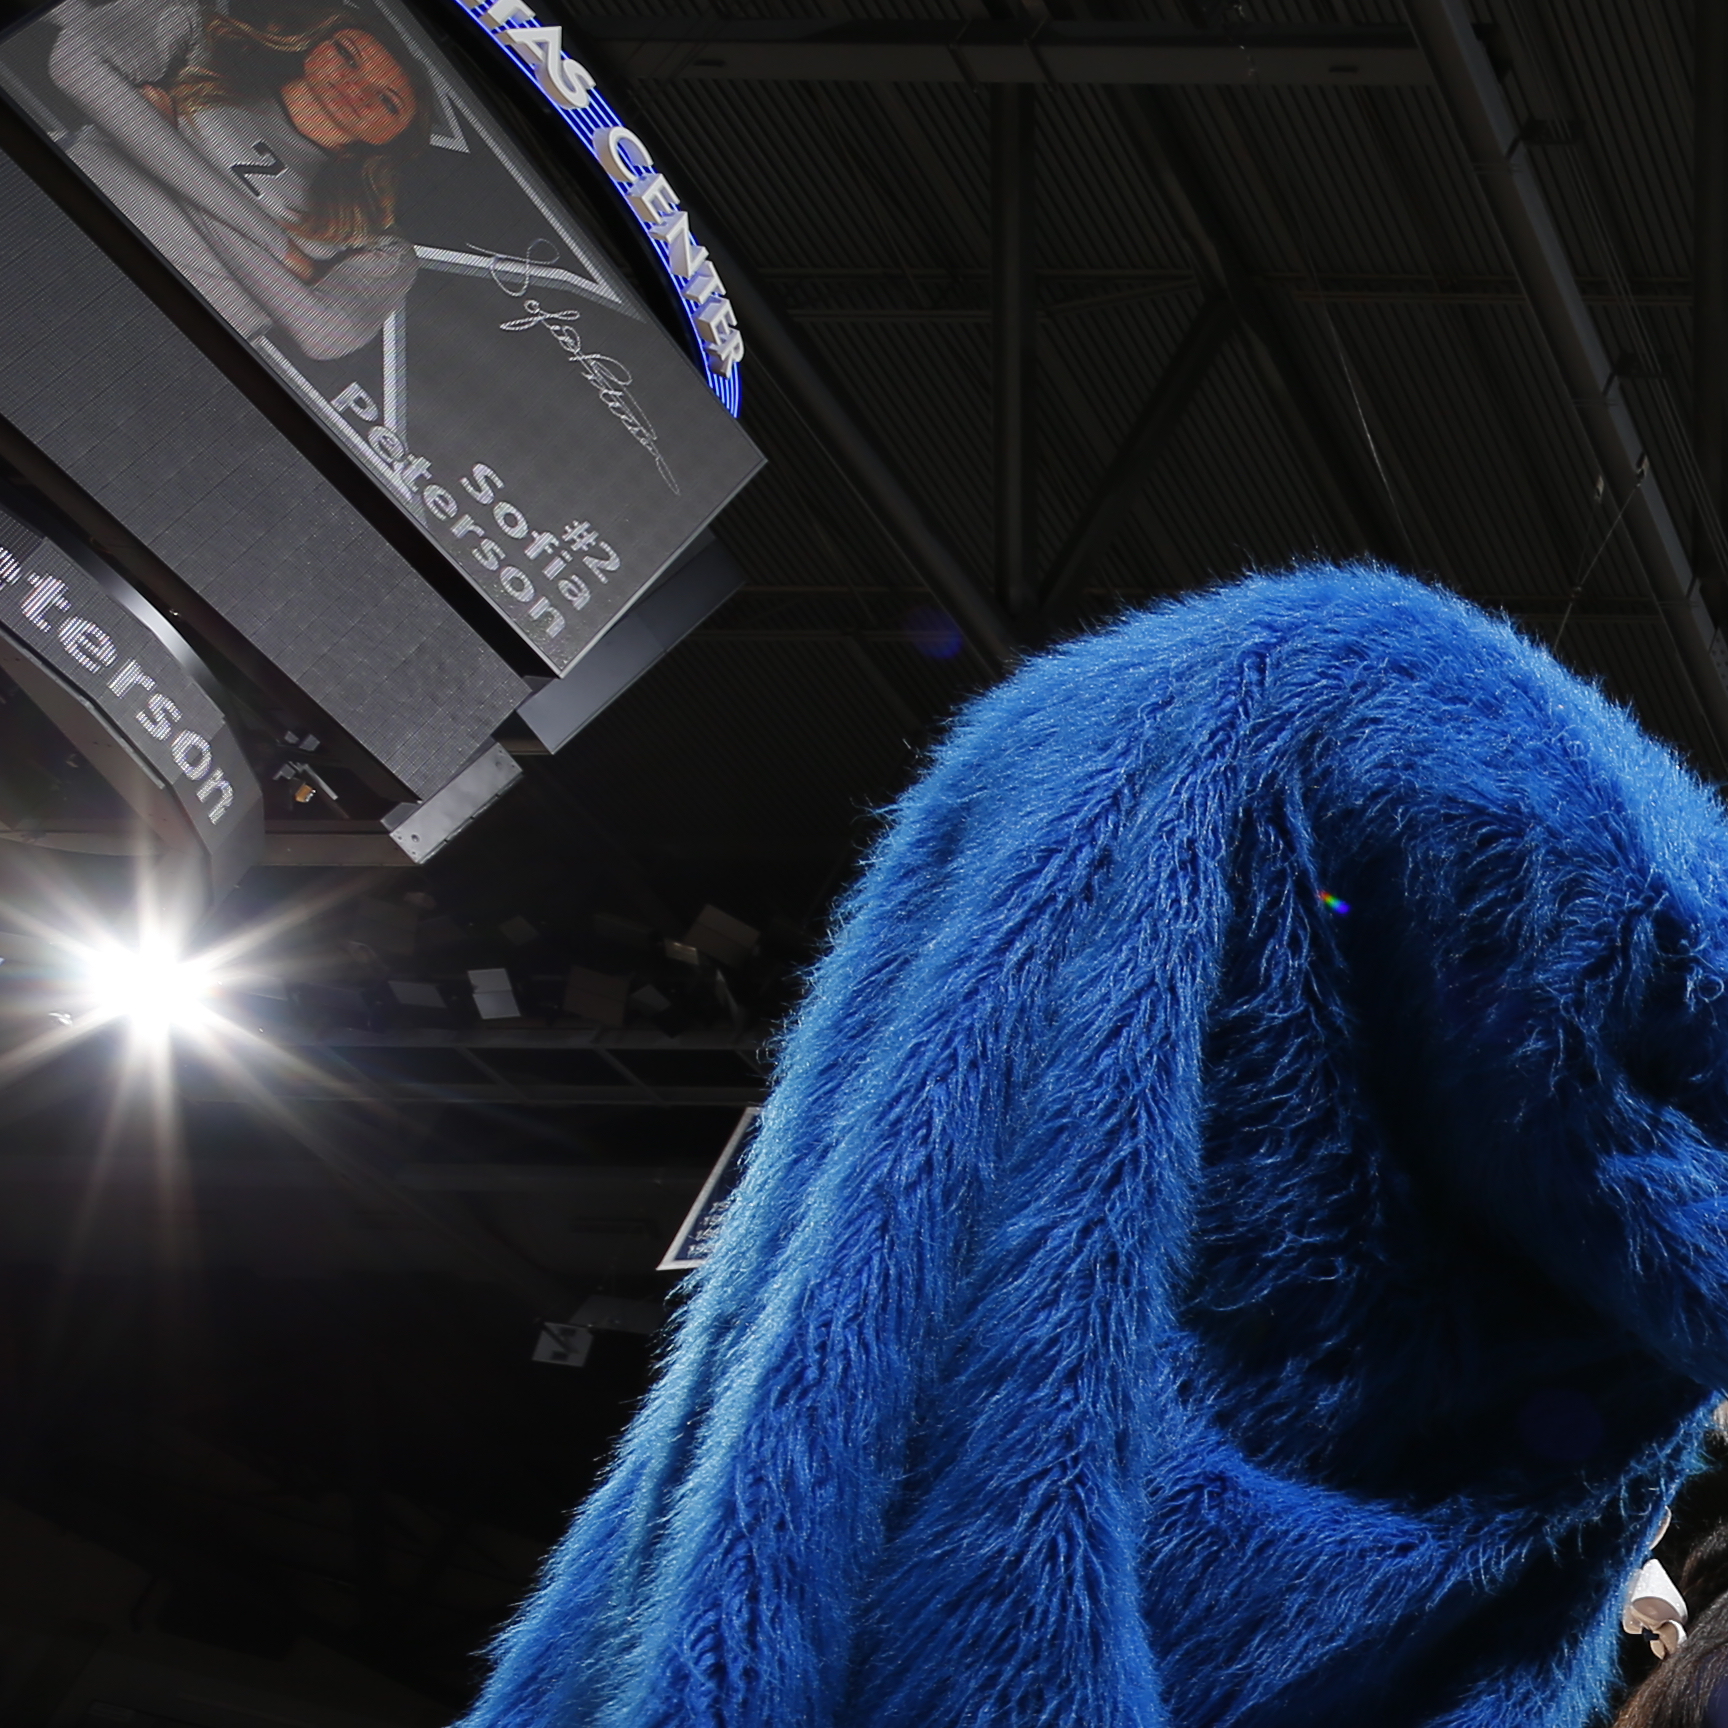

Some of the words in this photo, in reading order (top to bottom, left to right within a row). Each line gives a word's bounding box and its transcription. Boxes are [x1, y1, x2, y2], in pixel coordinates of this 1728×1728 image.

[232, 139, 289, 200] 2
[468, 0, 597, 110] TAS
[593, 125, 746, 378] CENTER
[329, 381, 567, 638] Peterson
[460, 462, 593, 611] Sofia
[561, 519, 621, 585] #2
